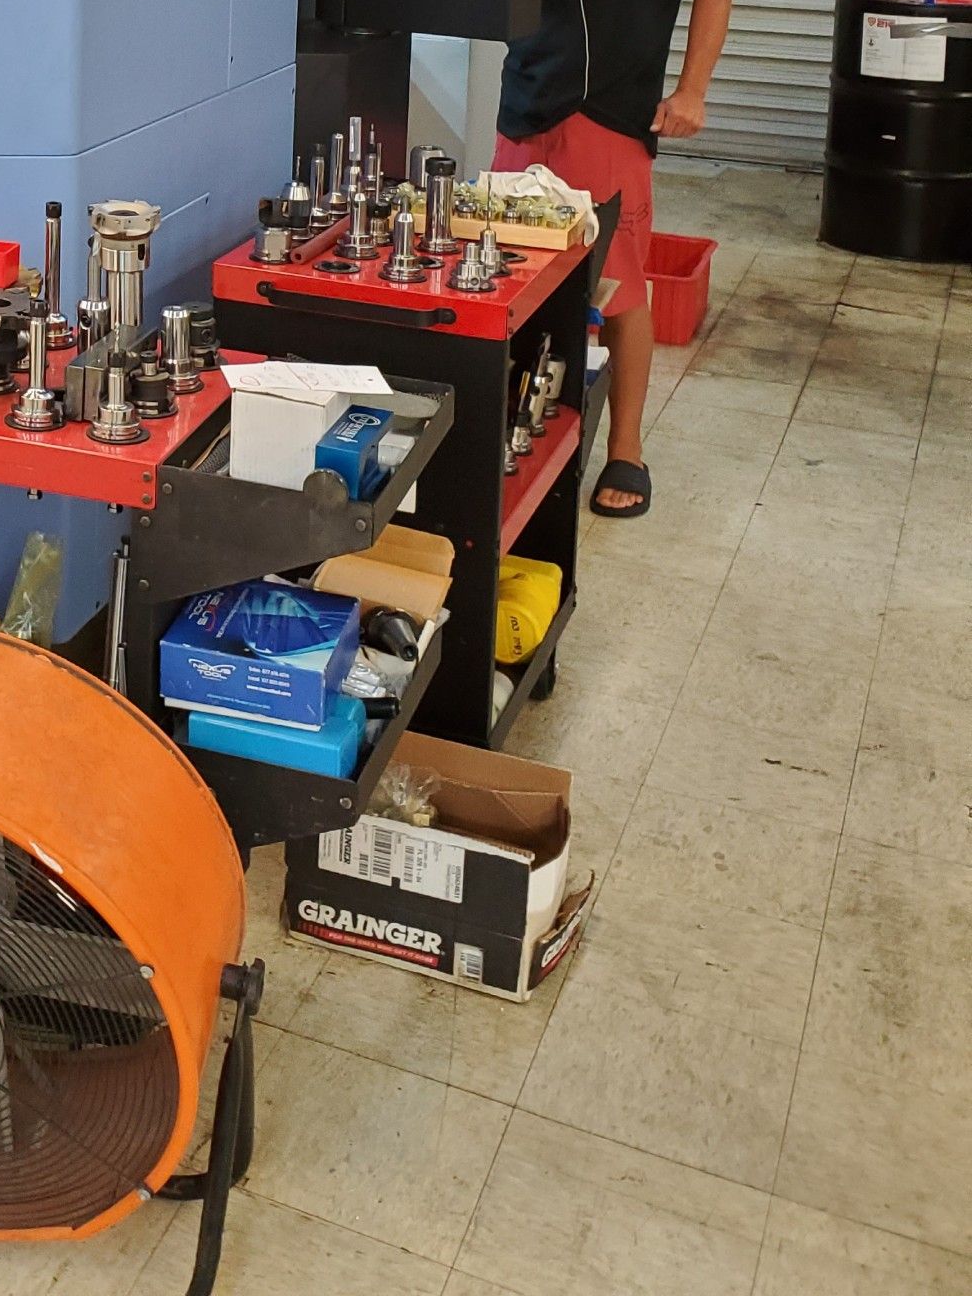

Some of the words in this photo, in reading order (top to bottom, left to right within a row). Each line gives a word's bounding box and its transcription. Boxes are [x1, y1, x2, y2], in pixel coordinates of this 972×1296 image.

[191, 662, 233, 676] NEXUS
[198, 668, 228, 680] TOOL
[343, 827, 353, 865] AINGER
[297, 899, 442, 955] GRAINGER
